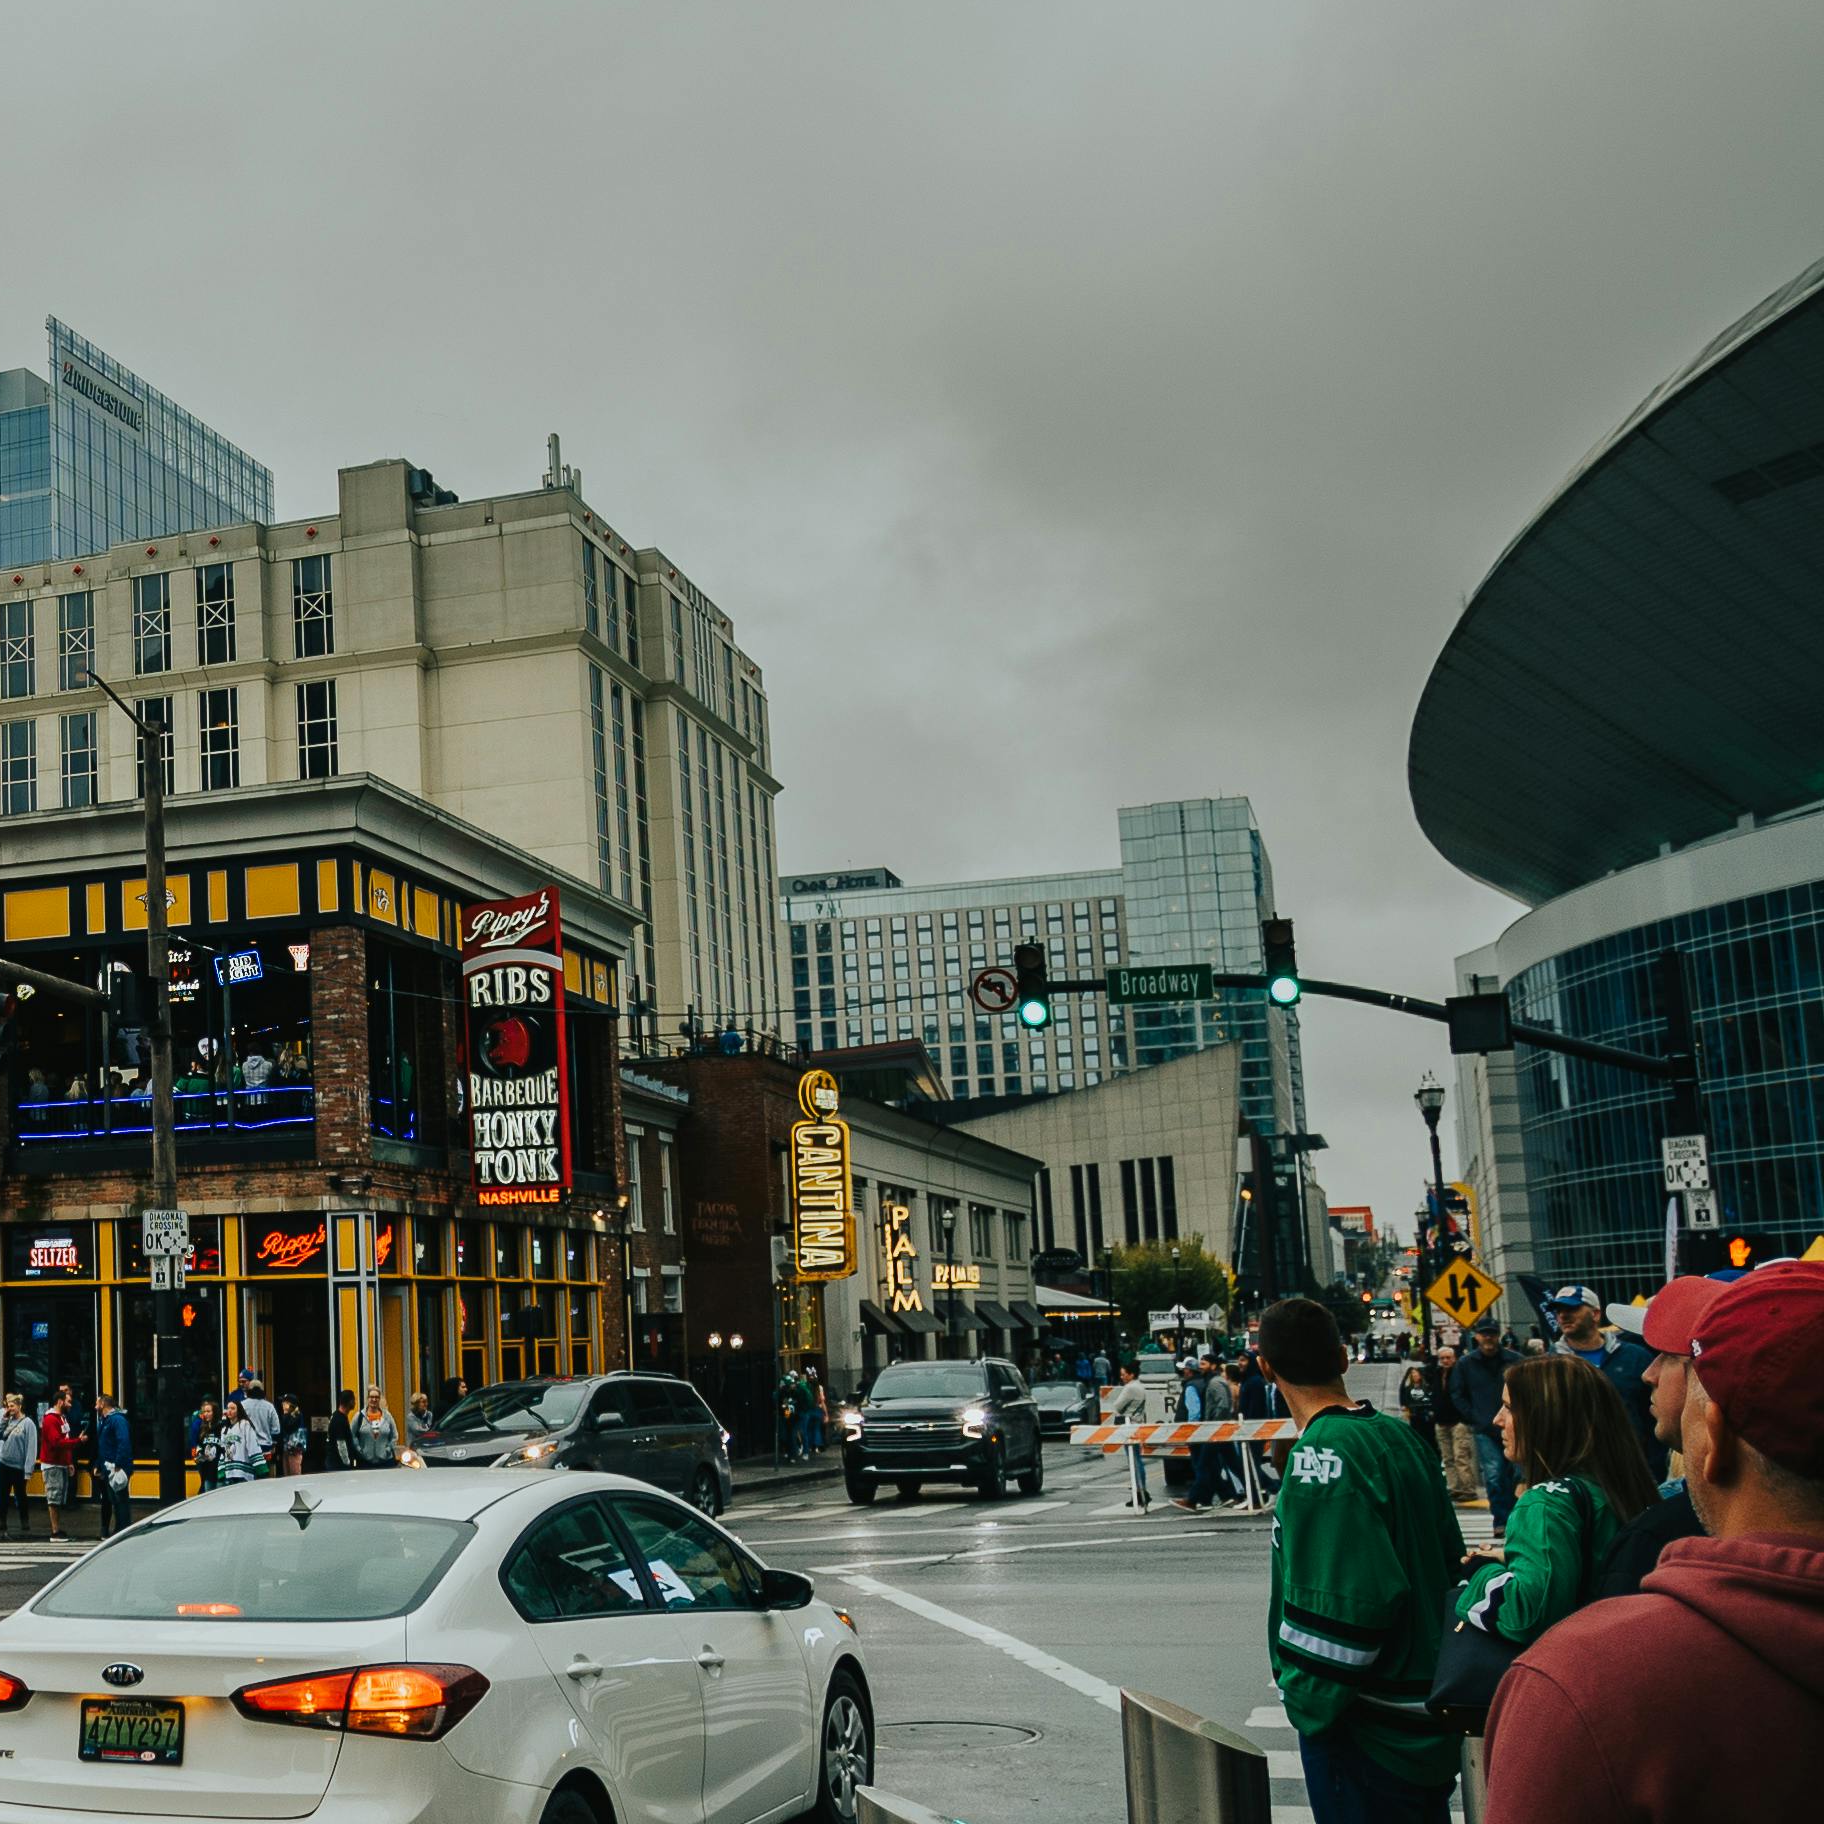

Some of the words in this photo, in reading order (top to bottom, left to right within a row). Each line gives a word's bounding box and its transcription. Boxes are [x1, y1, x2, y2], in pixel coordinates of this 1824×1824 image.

[463, 891, 551, 943] Rippy's
[469, 966, 551, 1008] RIBS
[1120, 968, 1200, 1000] Broadway
[469, 1066, 559, 1109] BARBEQUE
[472, 1110, 558, 1149] HONKY
[475, 1148, 559, 1185] TONK
[1666, 1164, 1684, 1184] OK
[478, 1188, 560, 1206] NASHVILLE
[696, 1202, 737, 1216] TACOS
[795, 1125, 845, 1268] CANTINA
[149, 1212, 183, 1221] DIAGONAL
[149, 1221, 184, 1230] CROSSING
[30, 1247, 78, 1267] SELTZER
[145, 1233, 163, 1250] OK
[256, 1224, 326, 1259] Rippy's
[892, 1206, 923, 1313] PALM
[107, 1666, 136, 1683] KIA
[87, 1715, 176, 1747] 47YY297
